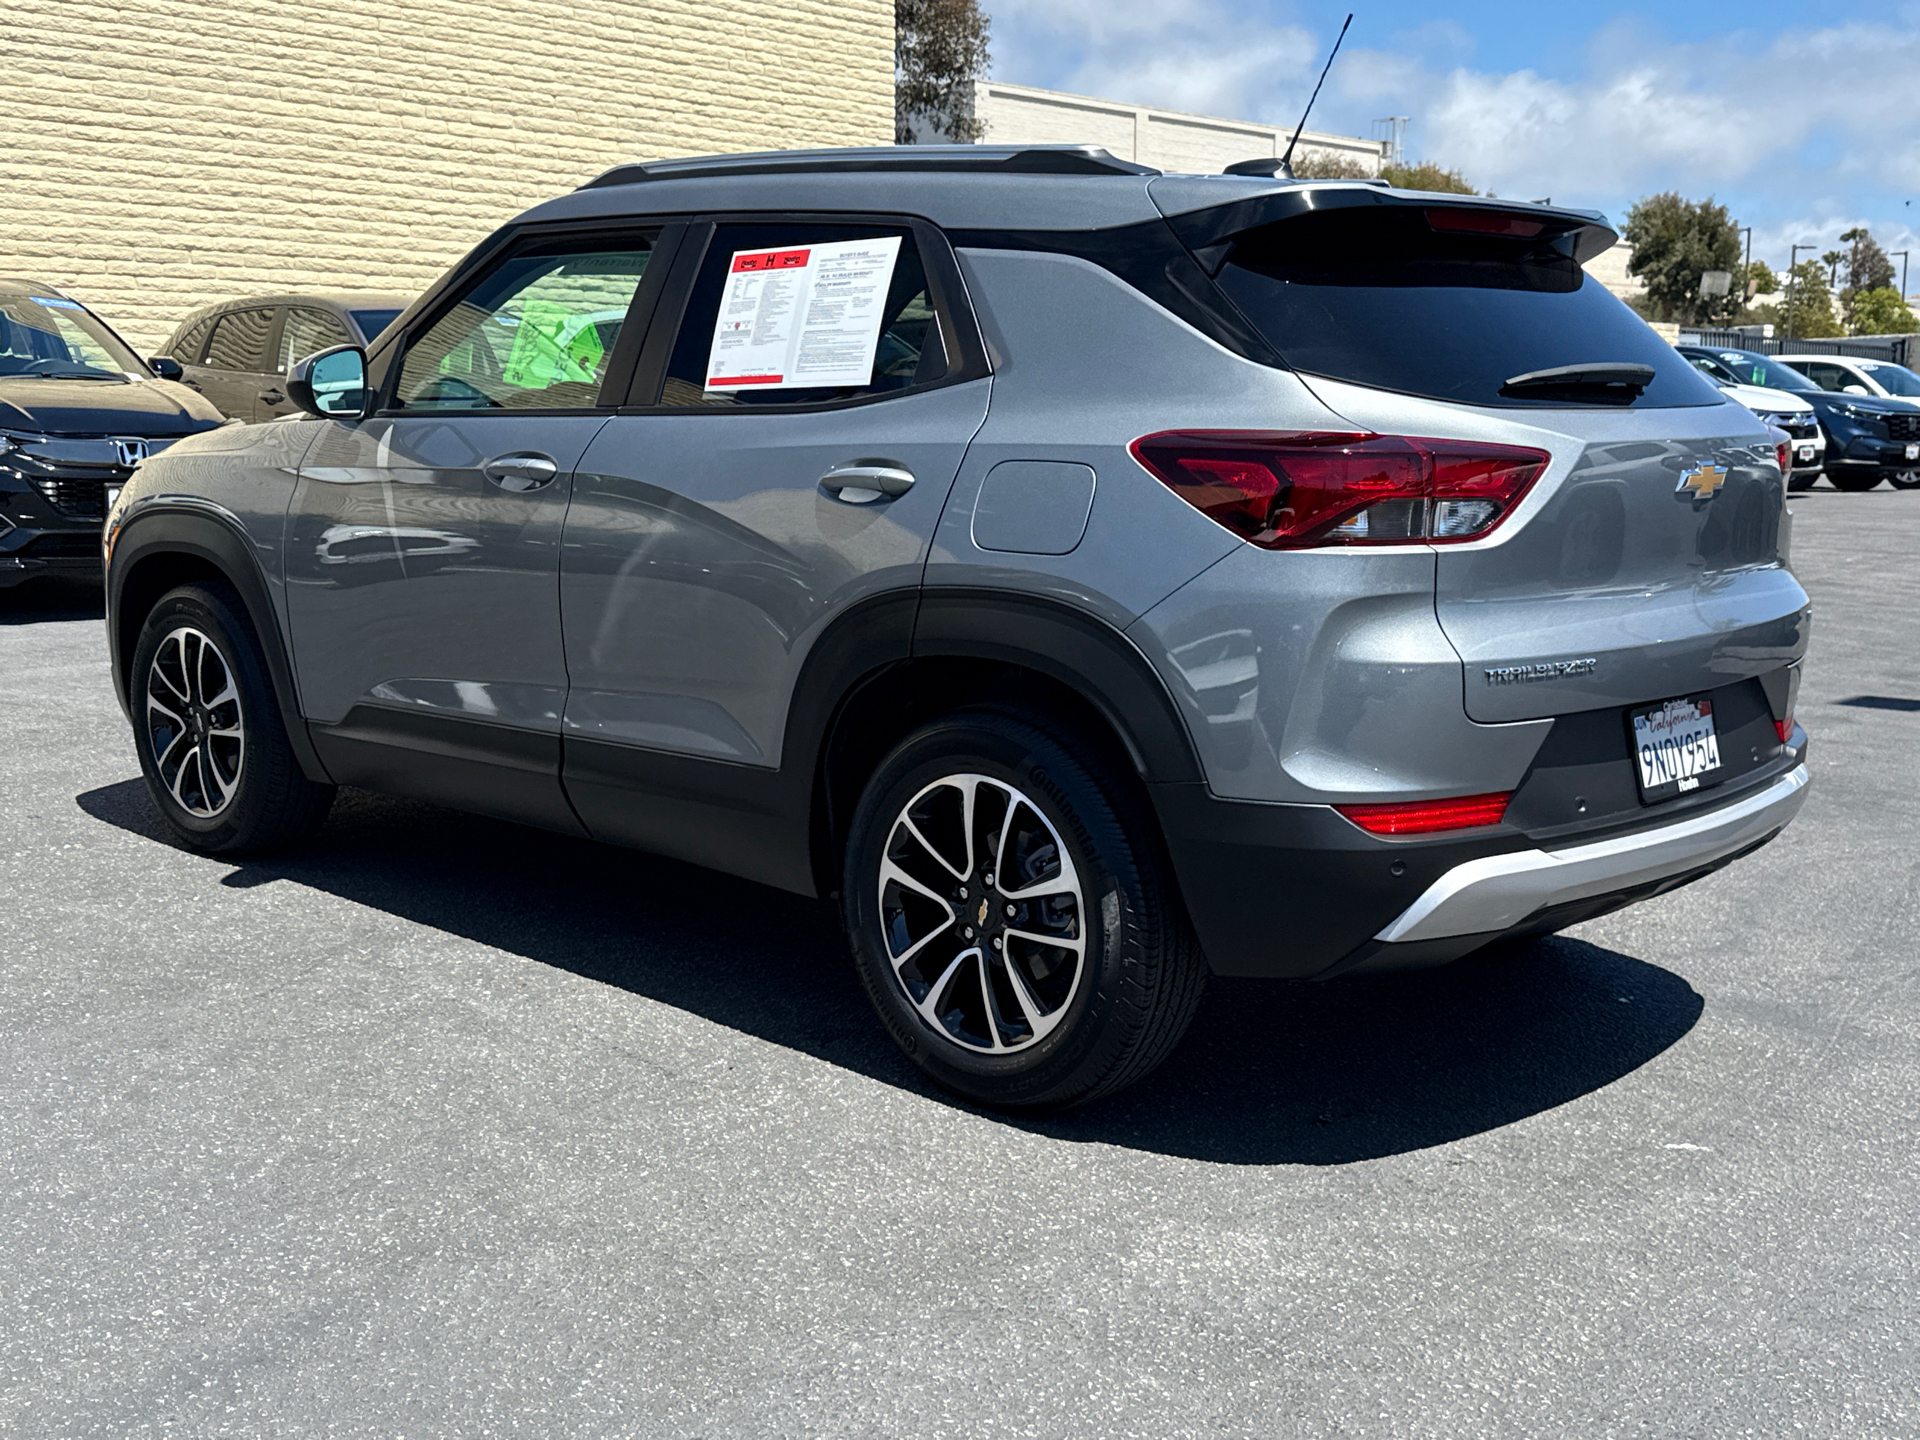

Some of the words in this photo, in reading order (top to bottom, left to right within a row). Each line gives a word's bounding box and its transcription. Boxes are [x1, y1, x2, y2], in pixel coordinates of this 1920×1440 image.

[1485, 658, 1597, 681] TRAILBLAZER
[1649, 708, 1700, 735] California
[1642, 728, 1717, 786] 9NOY954
[1029, 765, 1103, 863] Continental
